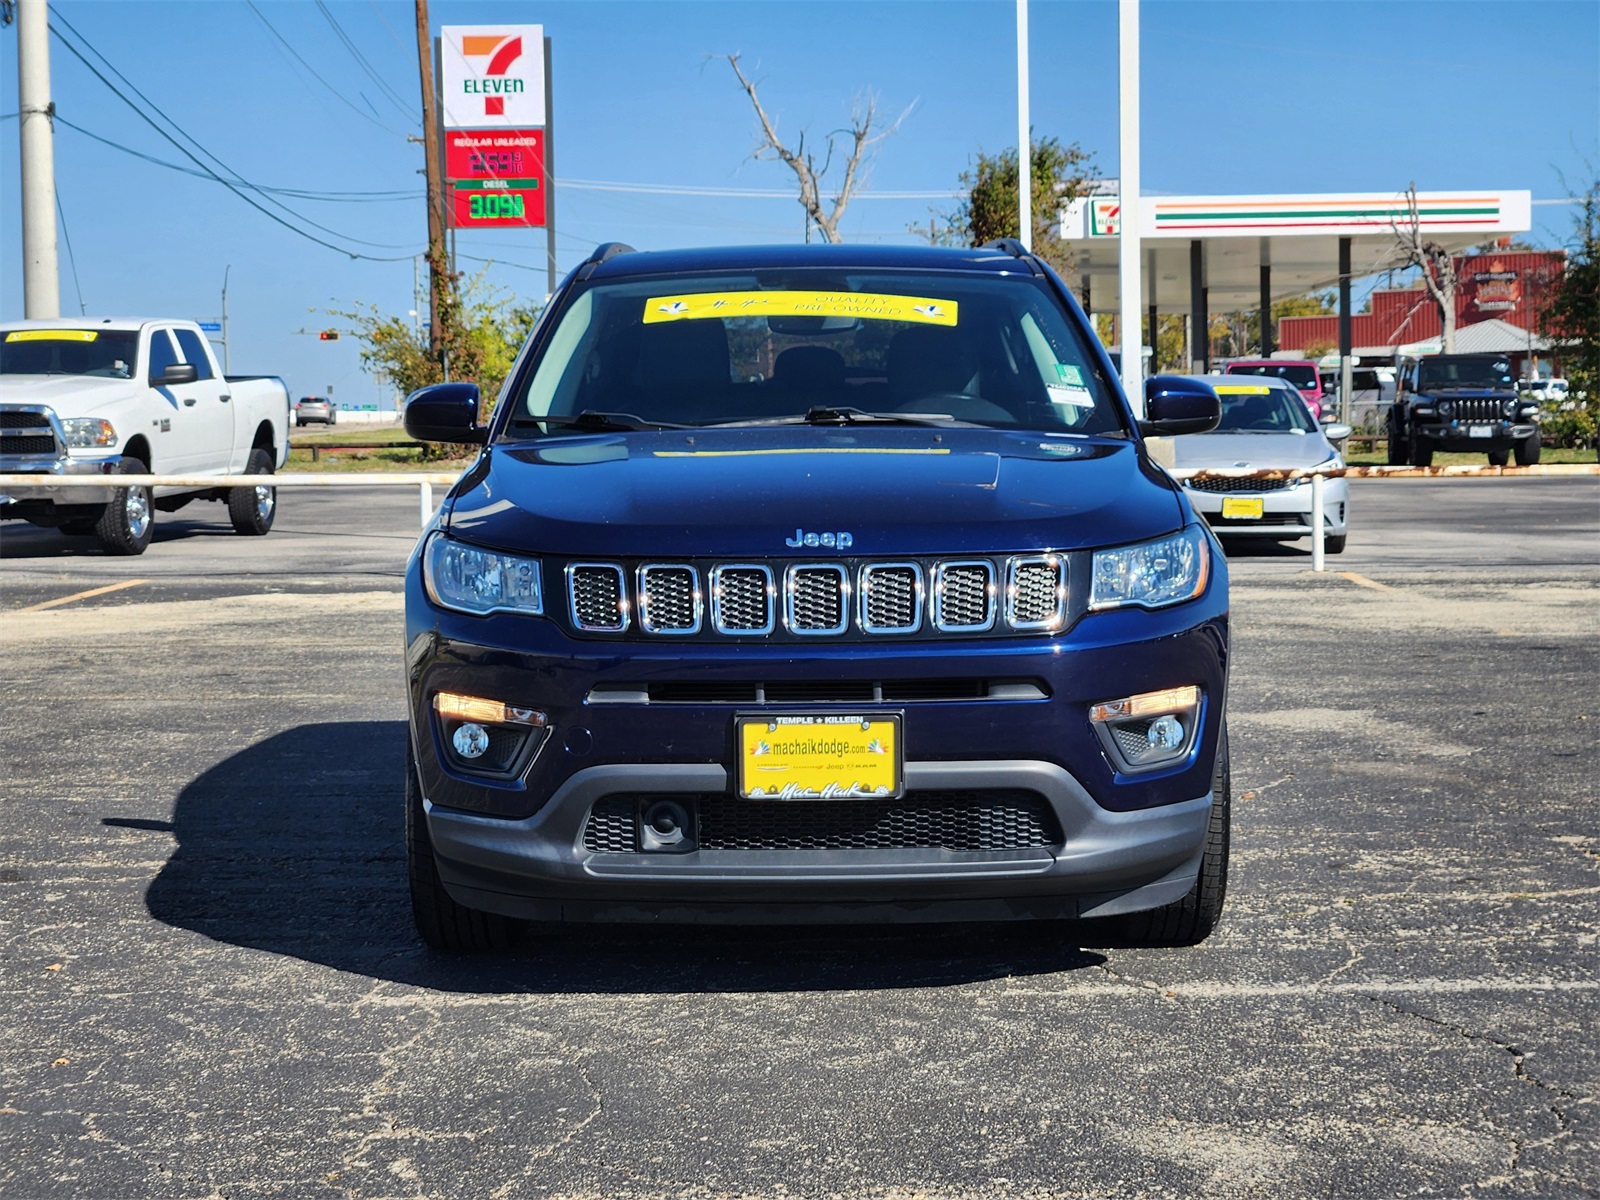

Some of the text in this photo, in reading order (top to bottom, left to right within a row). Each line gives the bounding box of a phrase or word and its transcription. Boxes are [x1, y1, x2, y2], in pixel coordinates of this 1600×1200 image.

[463, 36, 522, 115] 7
[454, 137, 537, 147] REGULAR UNLEADED
[483, 180, 509, 189] DIESEL
[786, 528, 853, 550] Jeep
[776, 716, 864, 725] TEMPLE KILLEEN
[773, 738, 866, 757] machaikdodge.com
[779, 782, 862, 800] Mac Haik
